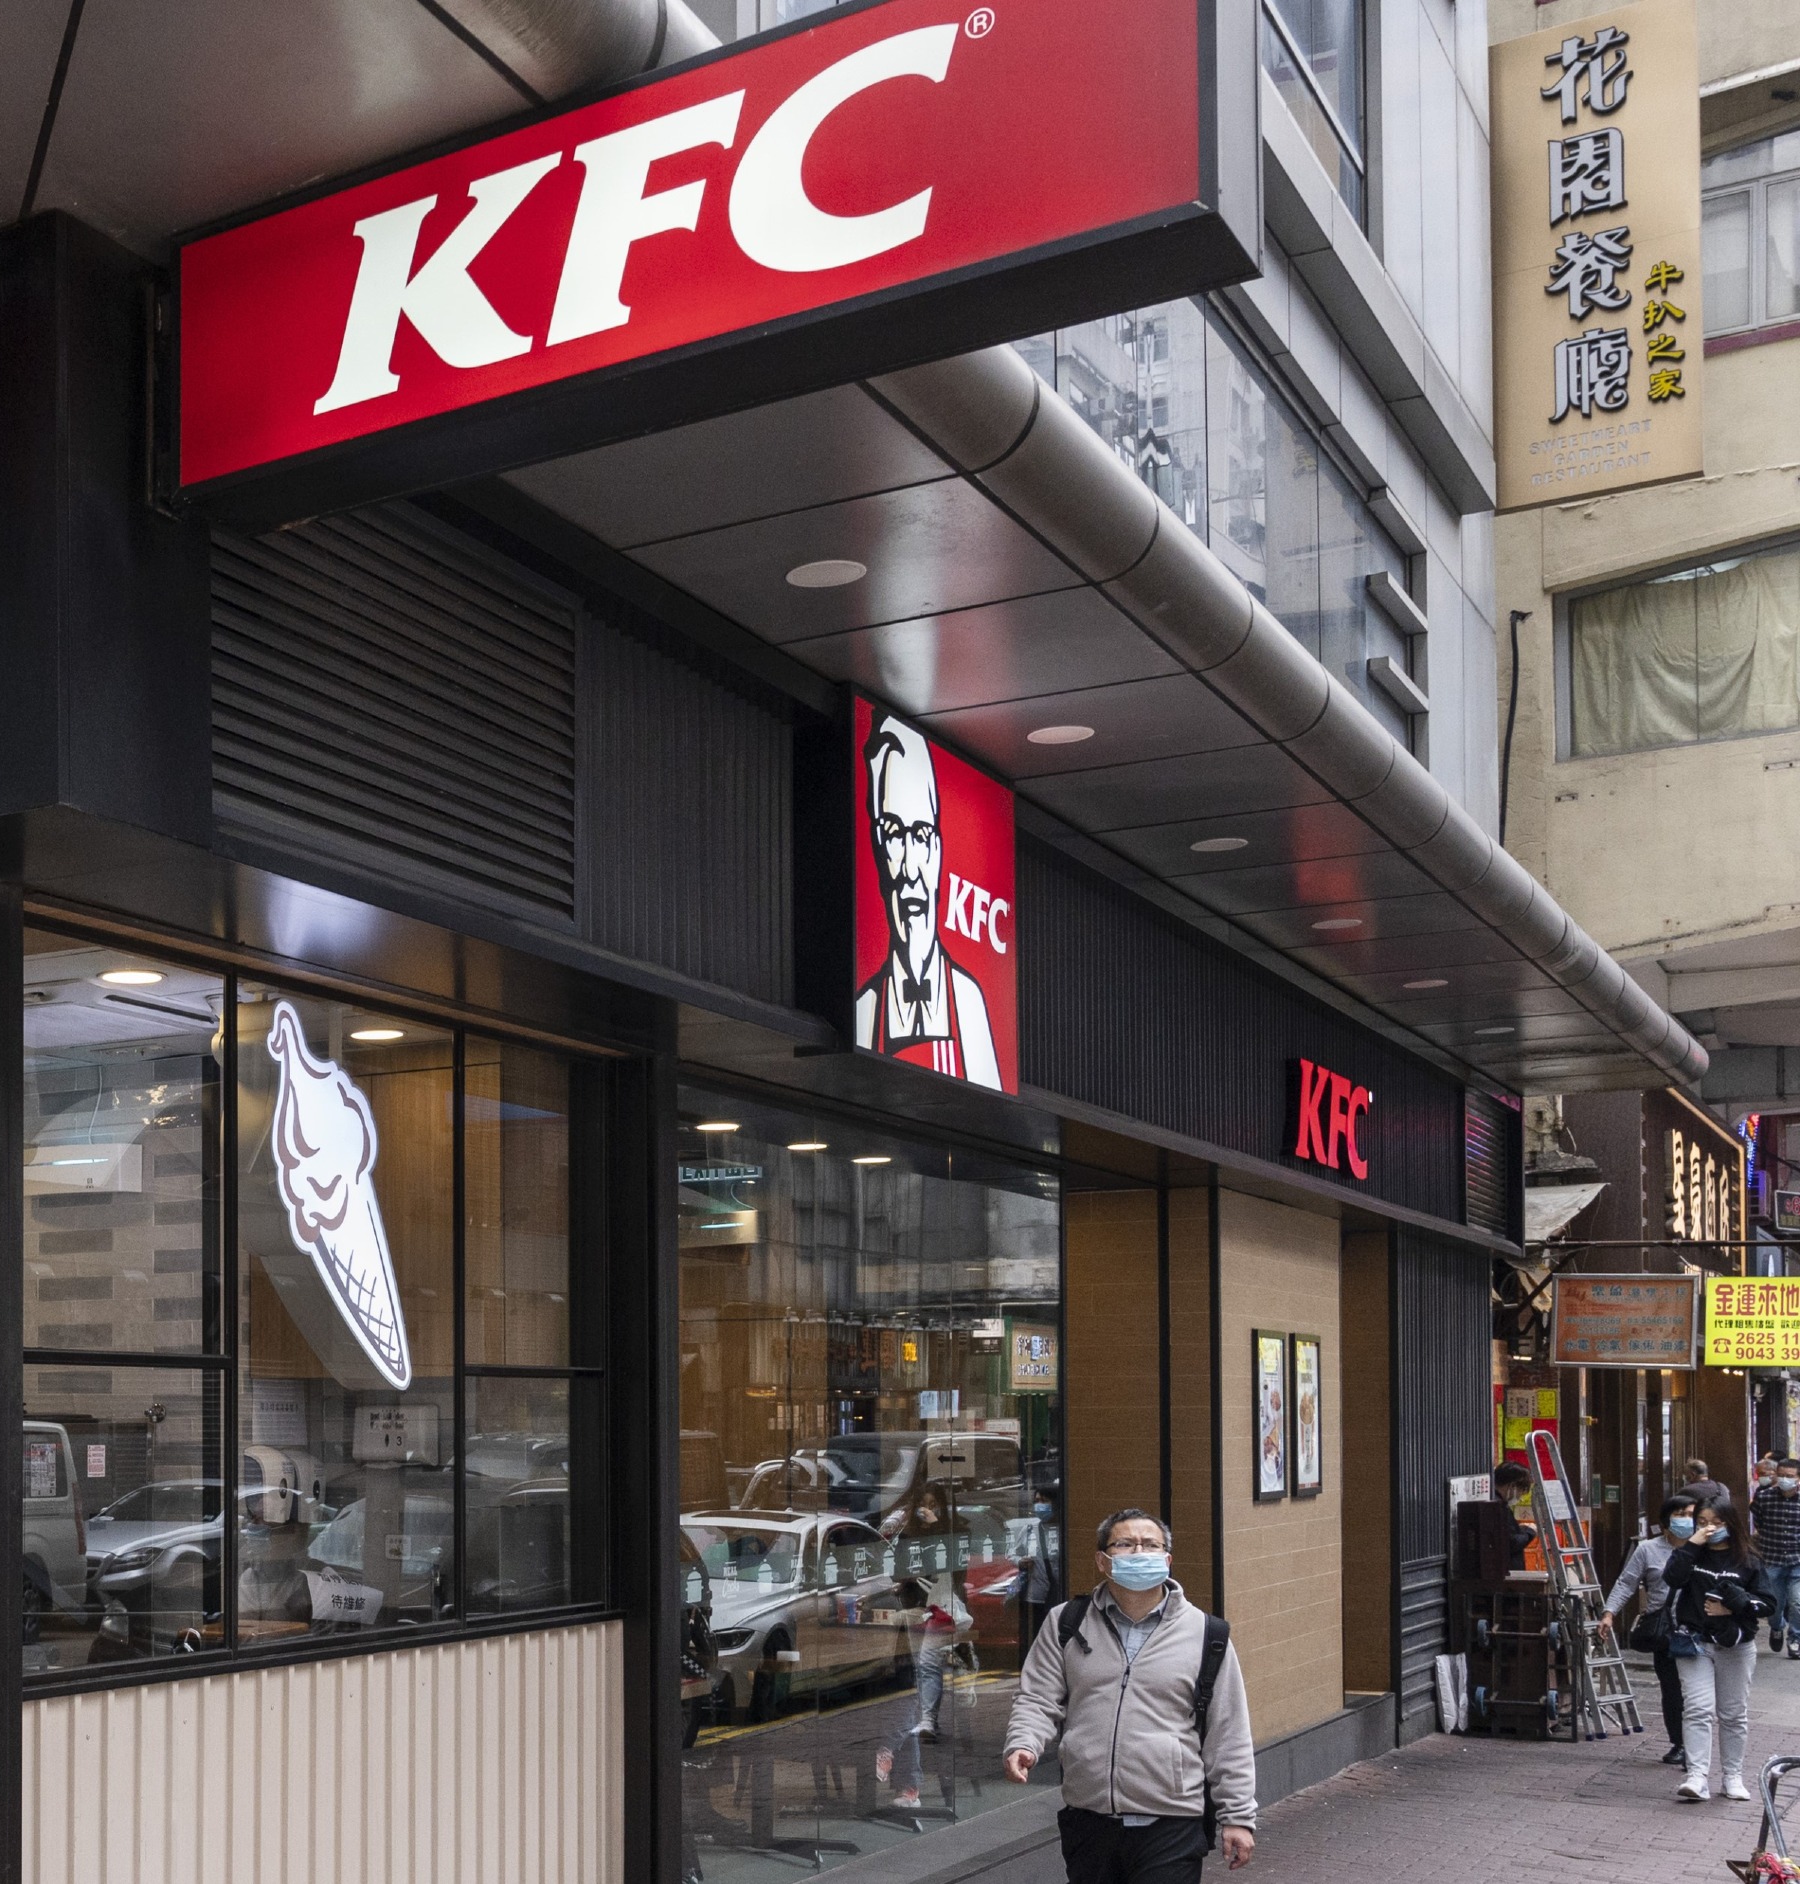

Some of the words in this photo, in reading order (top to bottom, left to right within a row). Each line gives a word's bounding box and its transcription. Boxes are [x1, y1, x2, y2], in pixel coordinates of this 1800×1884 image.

[313, 21, 959, 416] KFC
[1643, 260, 1686, 404] 牛扒之家
[1529, 418, 1653, 456] SWEETHEART
[1554, 439, 1630, 466] GARDEN
[1531, 451, 1652, 486] RESTAURANT
[944, 872, 1008, 954] KFC
[1295, 1058, 1368, 1179] KFC
[1714, 1283, 1800, 1316] 金運來地
[1735, 1332, 1775, 1345] 2625
[1781, 1332, 1800, 1345] 11
[1735, 1347, 1775, 1360] 9043
[1781, 1347, 1800, 1360] 39
[331, 1593, 367, 1611] 待維修
